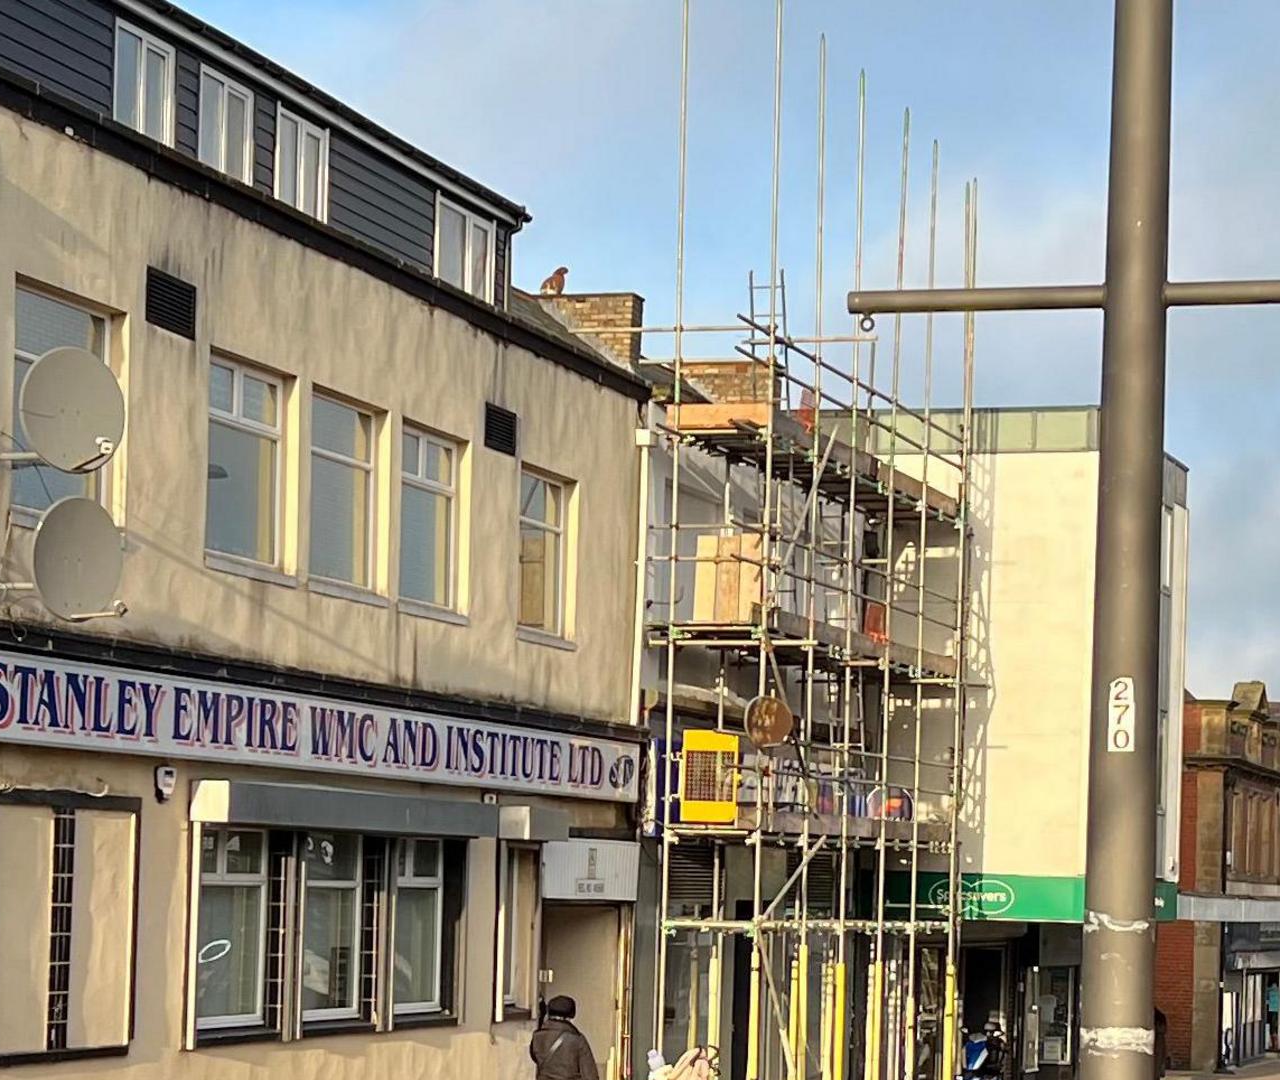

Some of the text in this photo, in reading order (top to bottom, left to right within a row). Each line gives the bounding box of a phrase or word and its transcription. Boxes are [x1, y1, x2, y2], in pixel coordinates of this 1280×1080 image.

[171, 686, 299, 755] EMPIRE
[310, 705, 377, 767] WMC
[382, 718, 438, 770] AND
[445, 725, 561, 781] INSTITUTE
[567, 742, 603, 788] LTD
[1113, 680, 1130, 749] 270
[936, 888, 1007, 902] Spcsavers
